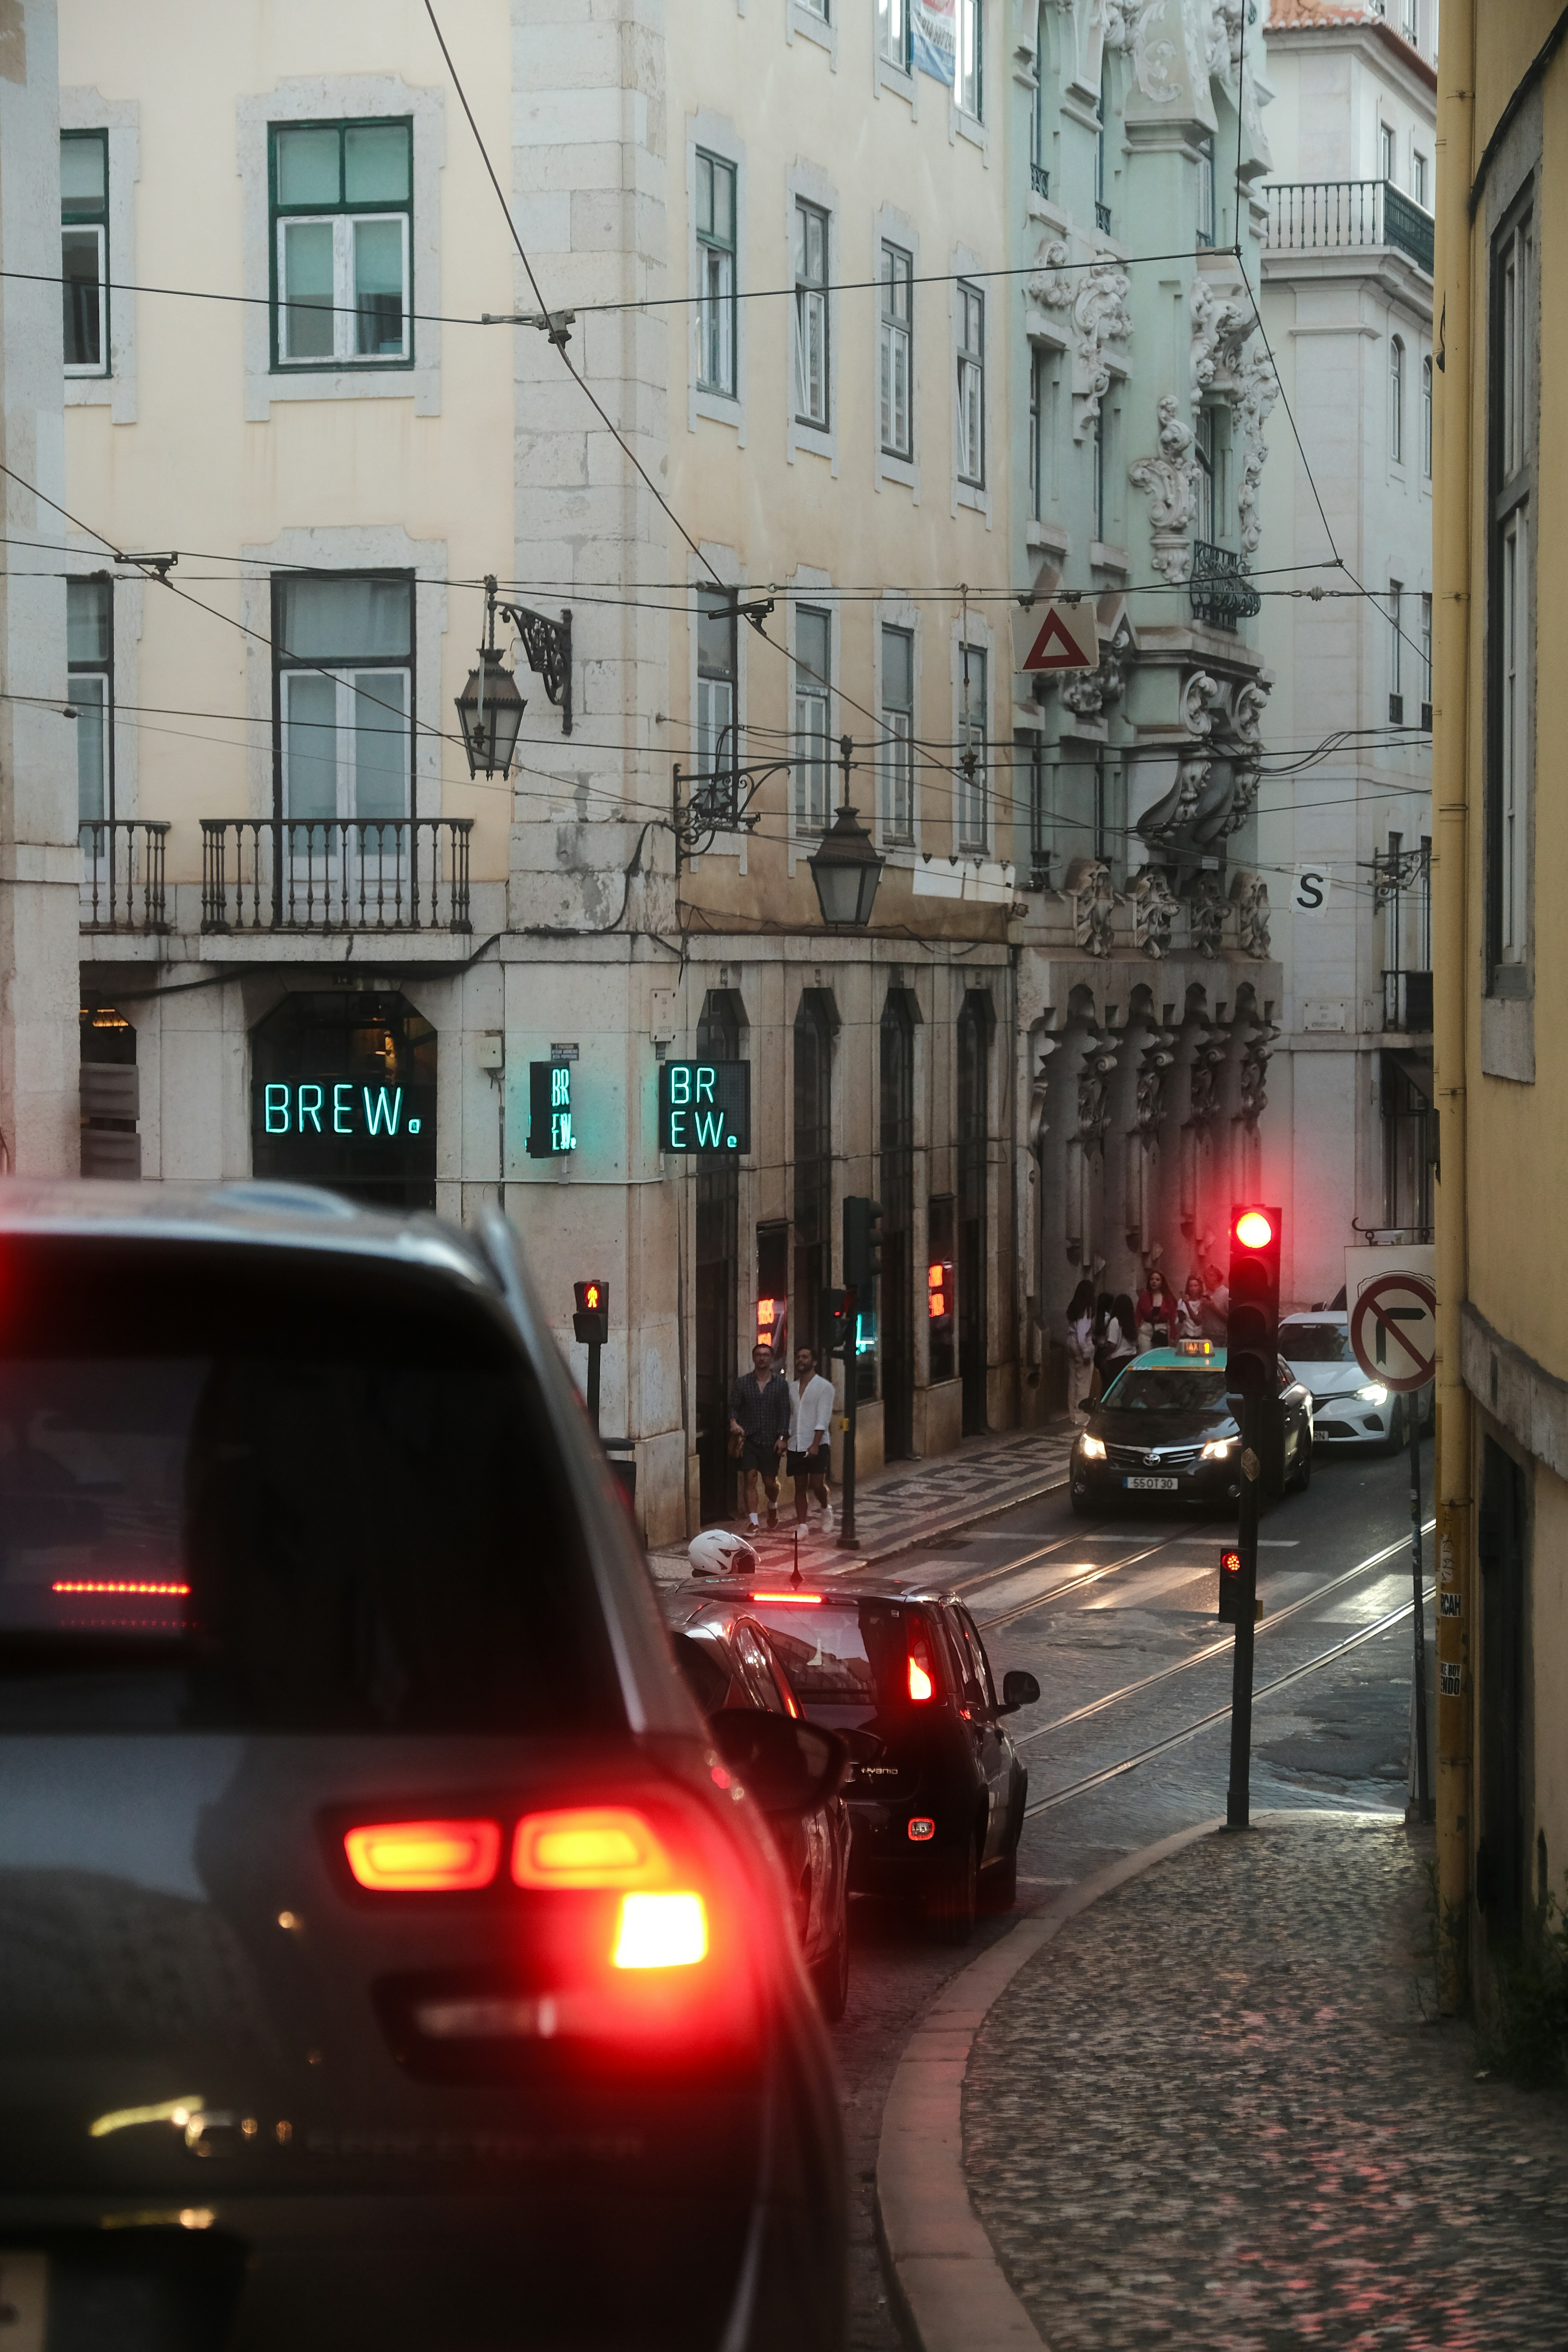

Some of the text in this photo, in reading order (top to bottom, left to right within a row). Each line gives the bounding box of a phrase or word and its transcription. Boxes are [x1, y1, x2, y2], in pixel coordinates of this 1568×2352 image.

[1297, 873, 1323, 908] S
[552, 1069, 570, 1107] BR
[671, 1067, 715, 1104] BR
